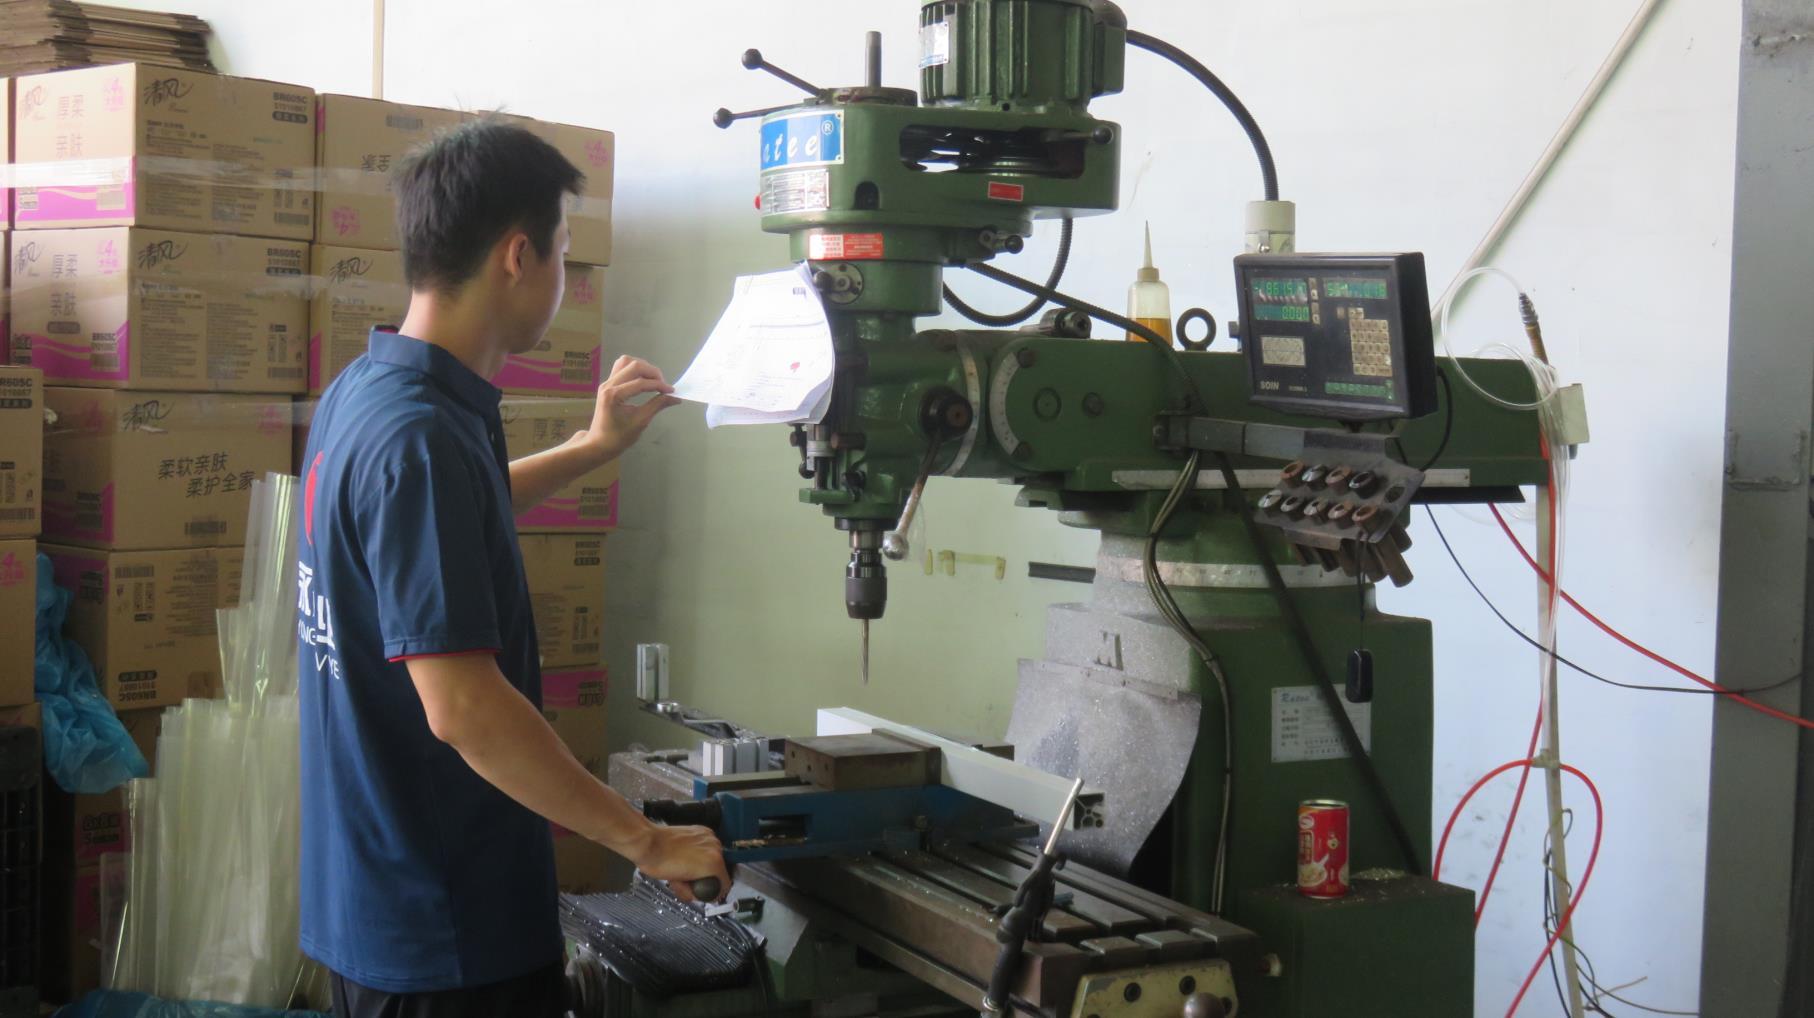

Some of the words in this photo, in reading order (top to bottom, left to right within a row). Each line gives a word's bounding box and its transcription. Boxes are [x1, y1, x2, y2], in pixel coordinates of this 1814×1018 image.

[158, 451, 228, 480] 柔软亲肤
[185, 470, 256, 499] 柔护全家
